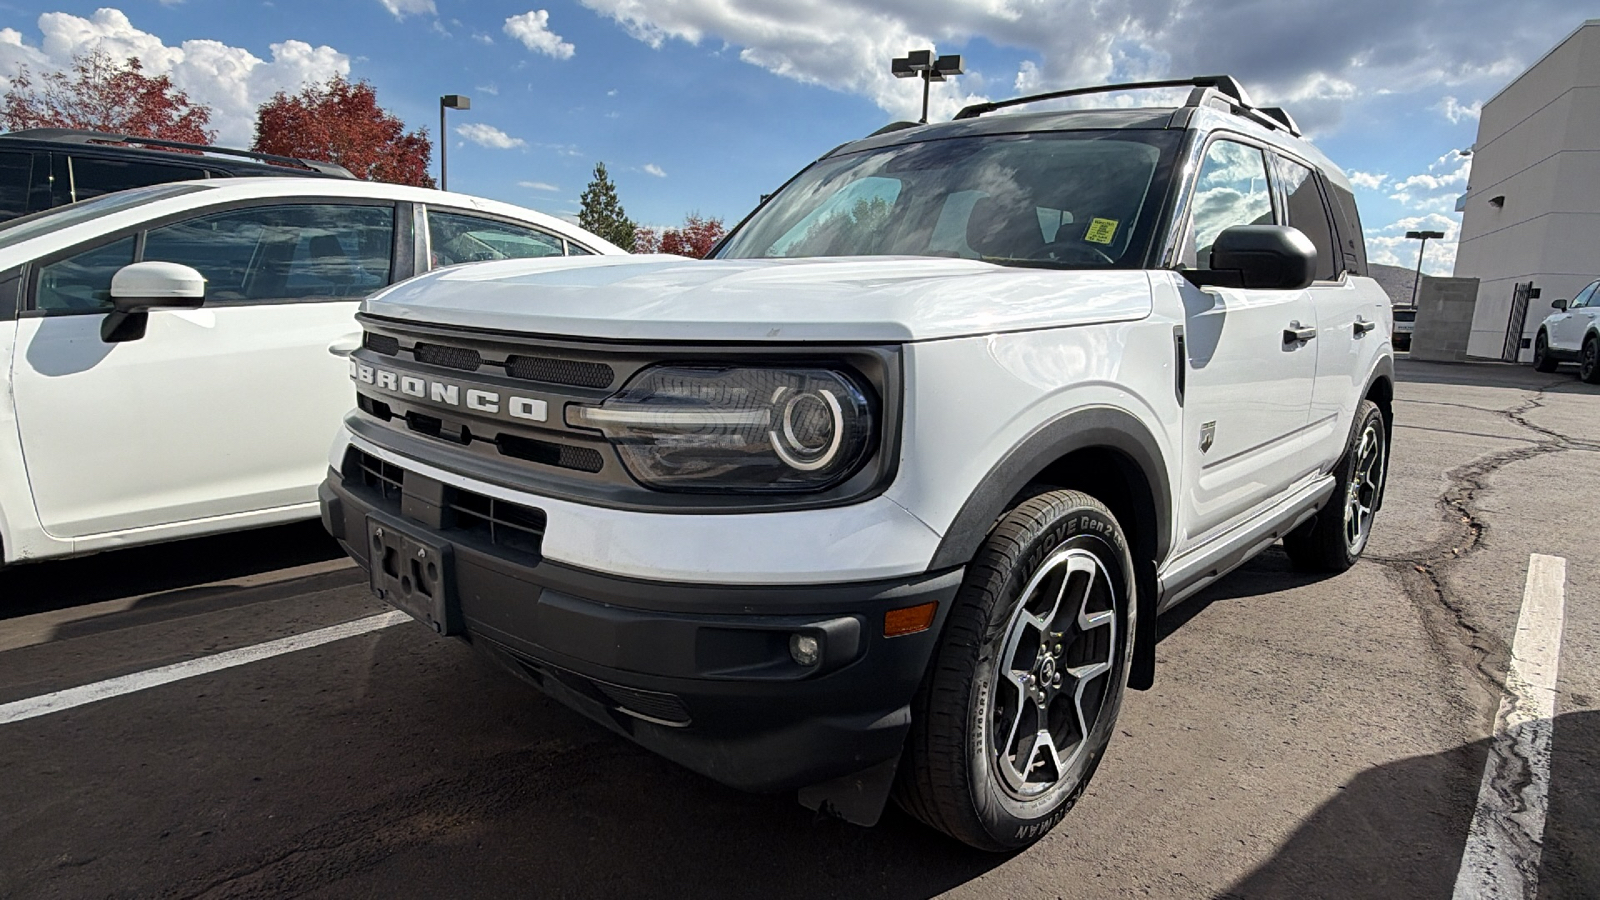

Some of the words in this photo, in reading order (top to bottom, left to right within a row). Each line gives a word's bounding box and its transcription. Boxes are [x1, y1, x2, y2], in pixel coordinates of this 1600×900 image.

[358, 364, 549, 422] BRONCO
[1080, 516, 1103, 532] Gen
[1104, 525, 1113, 537] 2
